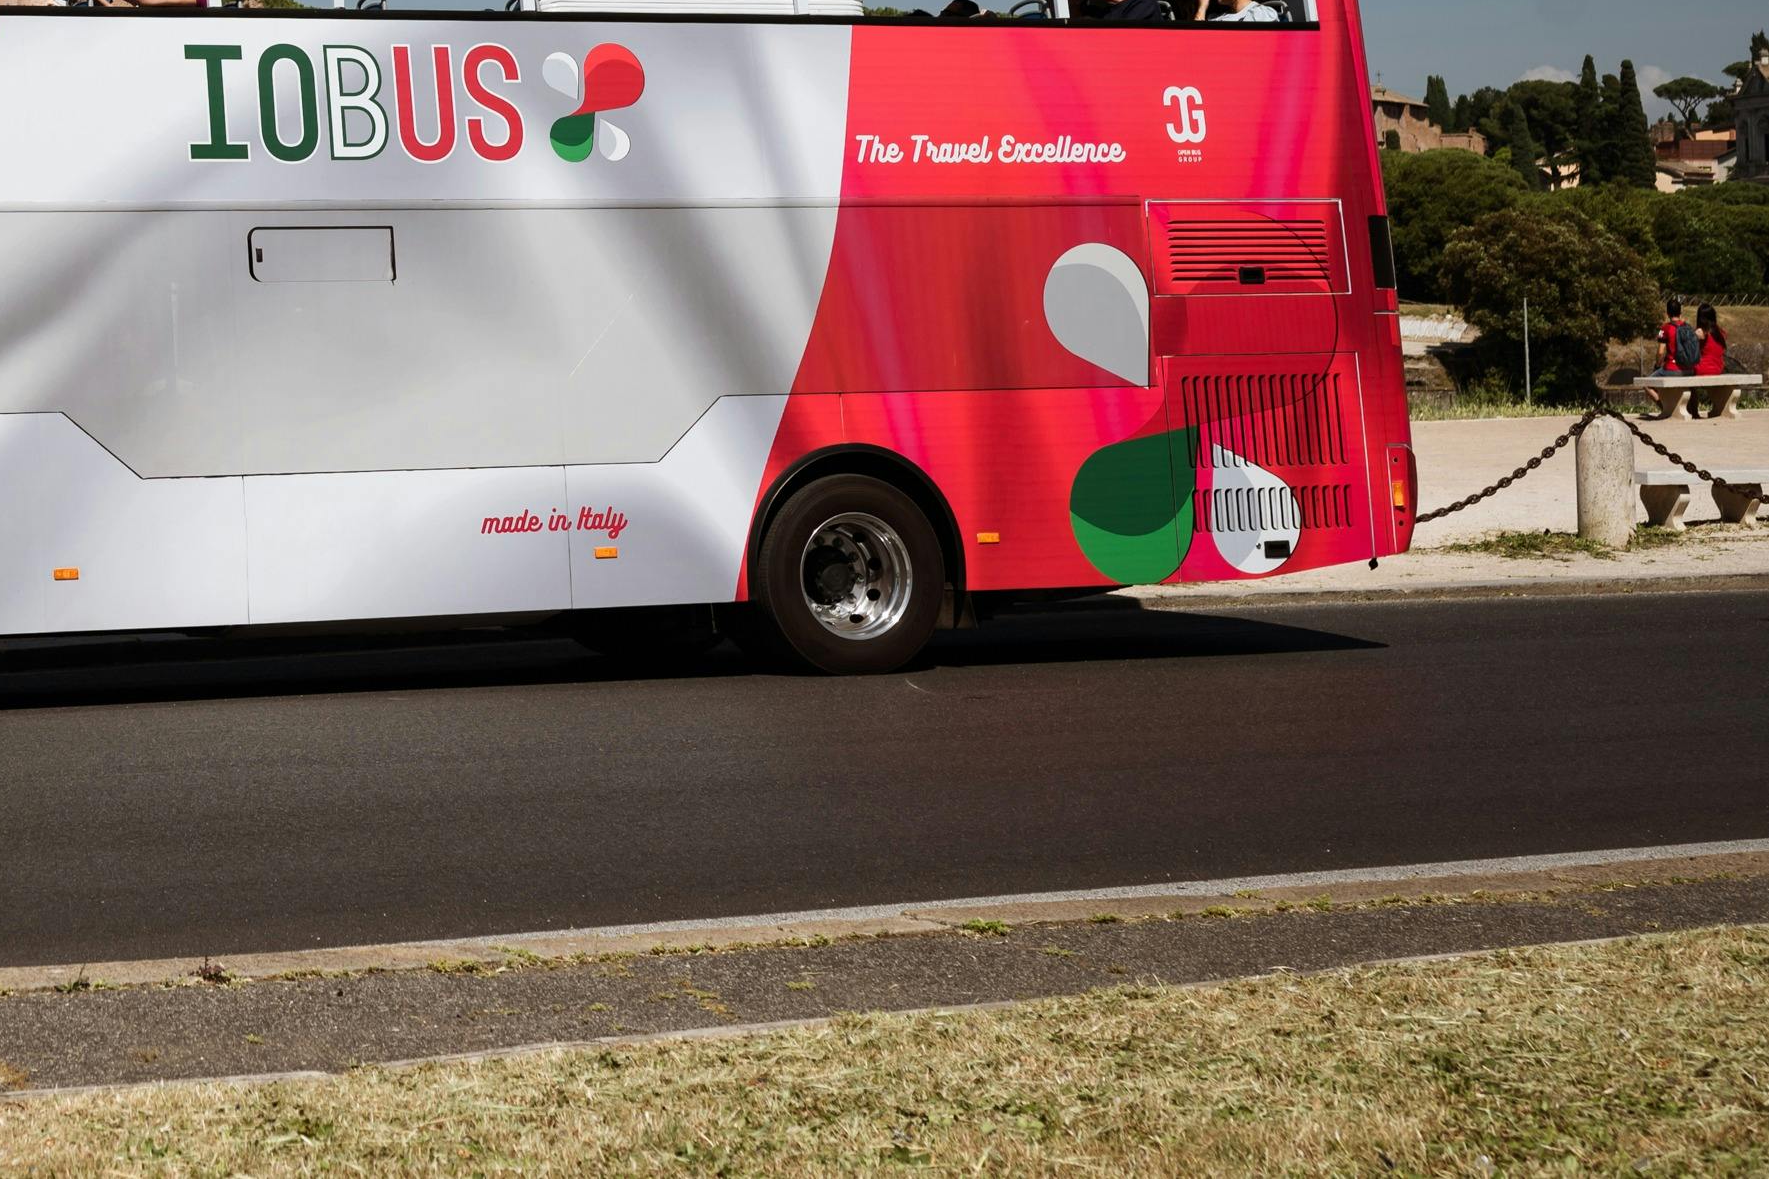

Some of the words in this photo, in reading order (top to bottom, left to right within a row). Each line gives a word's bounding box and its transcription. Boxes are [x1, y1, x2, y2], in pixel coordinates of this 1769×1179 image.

[183, 42, 524, 163] IOBUS
[855, 135, 904, 164] The
[910, 135, 993, 164] Travel
[997, 134, 1127, 164] Excellence
[481, 509, 543, 534] made
[548, 508, 572, 531] in
[576, 506, 628, 539] Italy
